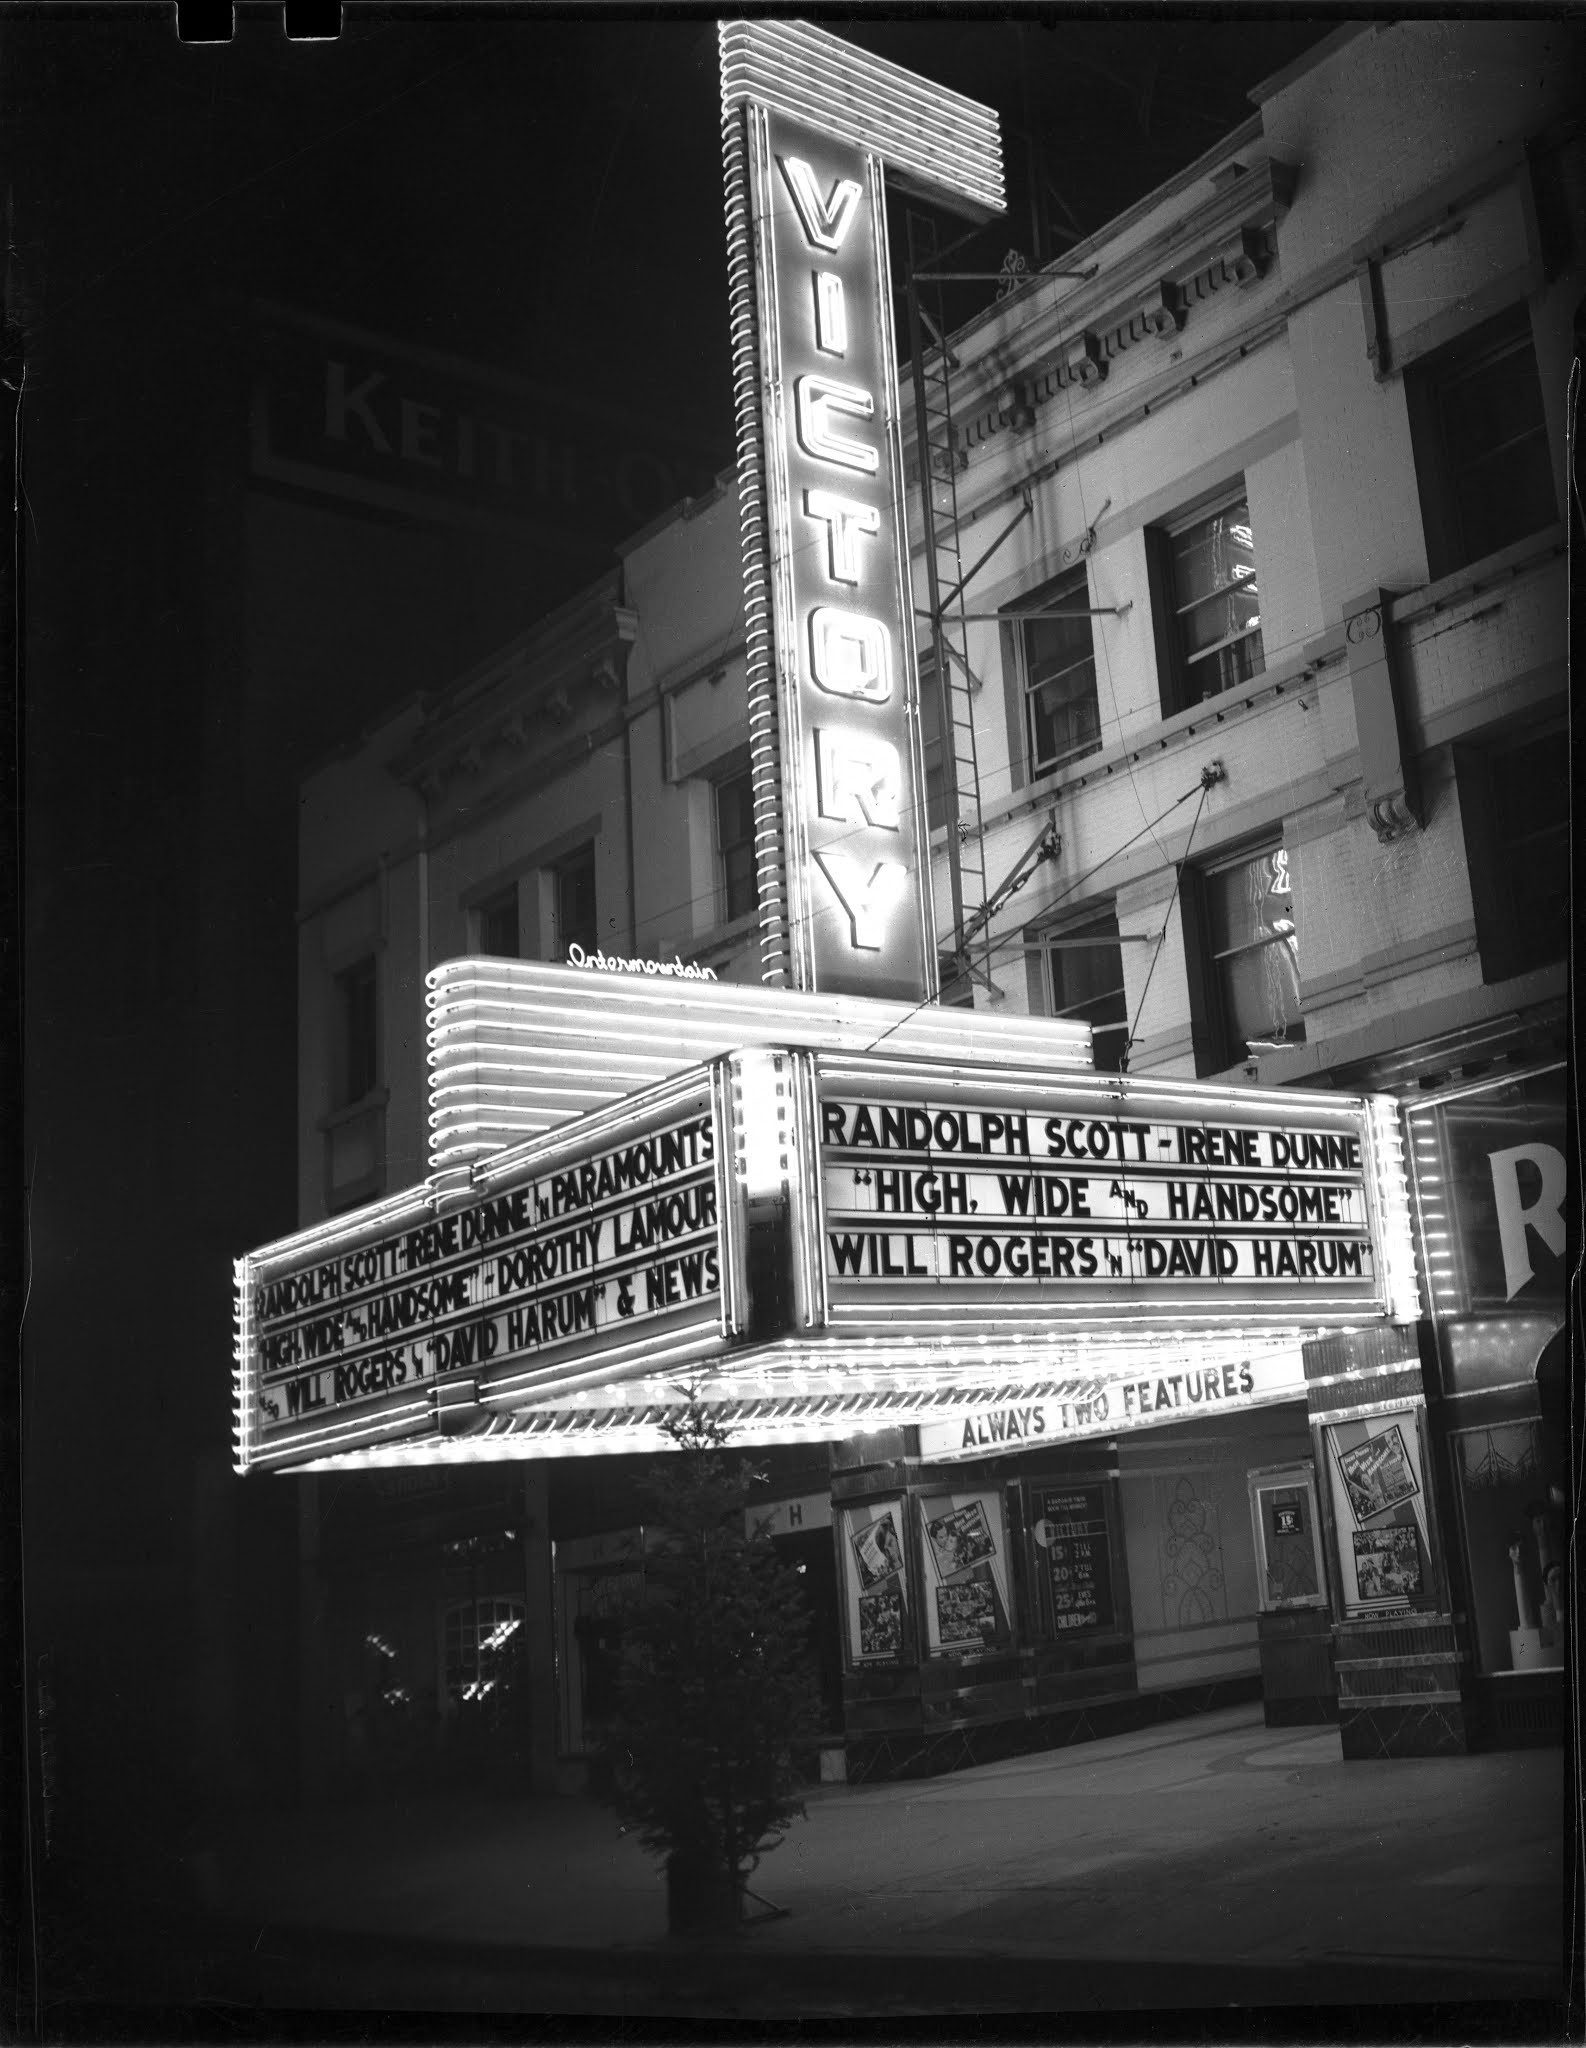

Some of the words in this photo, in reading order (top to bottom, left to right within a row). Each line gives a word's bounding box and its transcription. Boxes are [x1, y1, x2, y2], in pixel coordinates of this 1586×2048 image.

[775, 155, 906, 951] VICTORY
[461, 1189, 530, 1247] DUNNE
[550, 1116, 715, 1217] PARAMOUNTS
[821, 1102, 1031, 1155] RANDOLPH
[1044, 1118, 1150, 1162] SCOTT
[1177, 1126, 1262, 1167] IRENE
[1269, 1132, 1364, 1169] DUNNE
[853, 1168, 978, 1213] "HIGH,
[998, 1174, 1091, 1218] WIDE
[1109, 1180, 1149, 1219] AND
[1167, 1182, 1353, 1222] HANDSOME"
[302, 1315, 345, 1359] WIDE
[499, 1220, 603, 1295] DOROTHY
[613, 1182, 718, 1257] LAMOUR
[828, 1233, 928, 1275] WILL
[950, 1235, 1098, 1276] ROGERS
[1103, 1238, 1123, 1277] IN
[1125, 1238, 1239, 1277] "DAVID
[1251, 1239, 1374, 1277] HARUM"
[285, 1374, 326, 1416] WILL
[334, 1346, 407, 1402] ROGERS
[616, 1275, 636, 1317] &
[646, 1250, 720, 1311] NEWS
[962, 1405, 1047, 1448] ALWAYS
[1059, 1392, 1110, 1428] TWO
[1122, 1360, 1255, 1415] FEATURES
